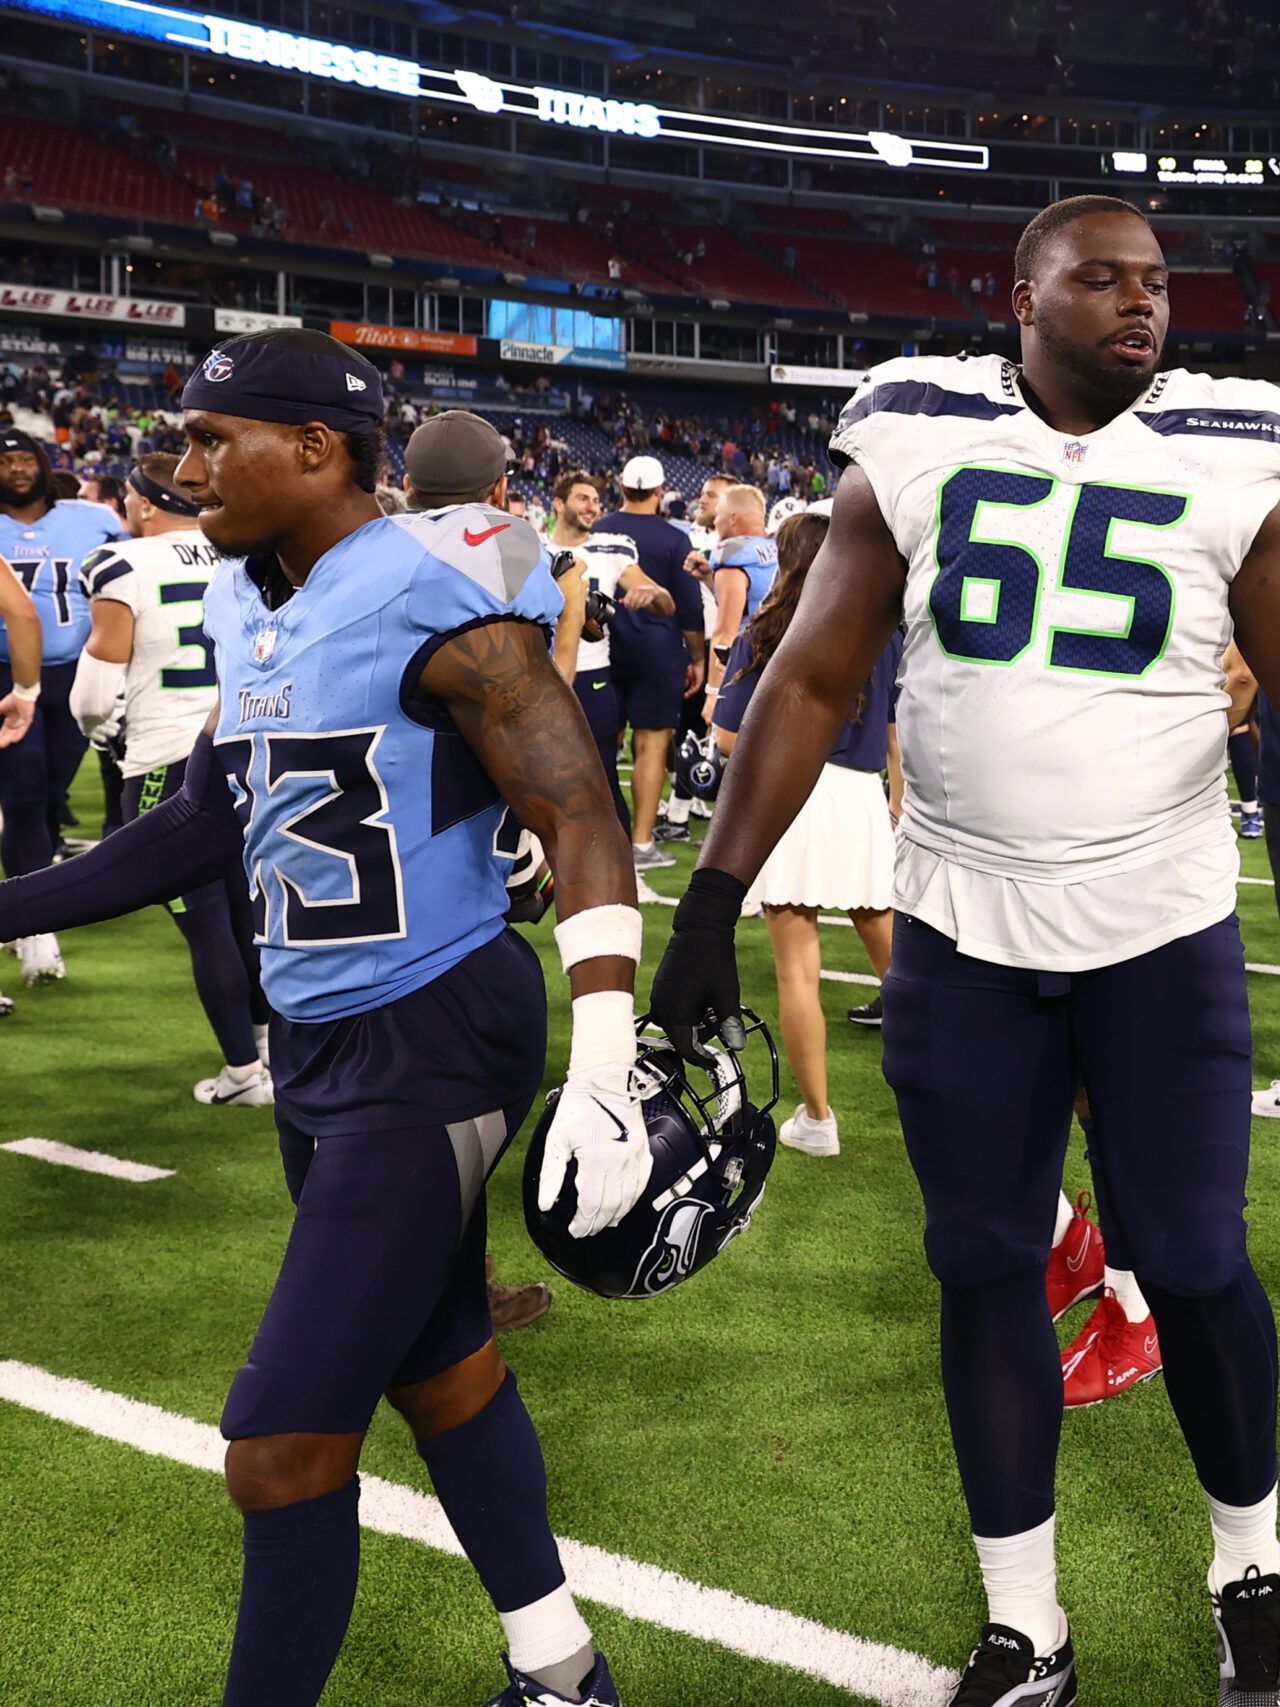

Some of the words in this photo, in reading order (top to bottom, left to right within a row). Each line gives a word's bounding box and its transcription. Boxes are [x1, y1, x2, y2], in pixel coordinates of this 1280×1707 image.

[204, 15, 420, 97] TENNESSEE
[534, 86, 661, 138] TITANS
[22, 291, 55, 305] LEE
[84, 298, 118, 313] LEE
[144, 304, 178, 318] LEE
[355, 326, 398, 345] Tito's
[502, 341, 555, 362] Pinnacle
[927, 464, 1193, 680] 65
[239, 683, 292, 724] TITANS
[1115, 1367, 1138, 1386] ALPHA
[988, 1634, 1020, 1651] ALPHA
